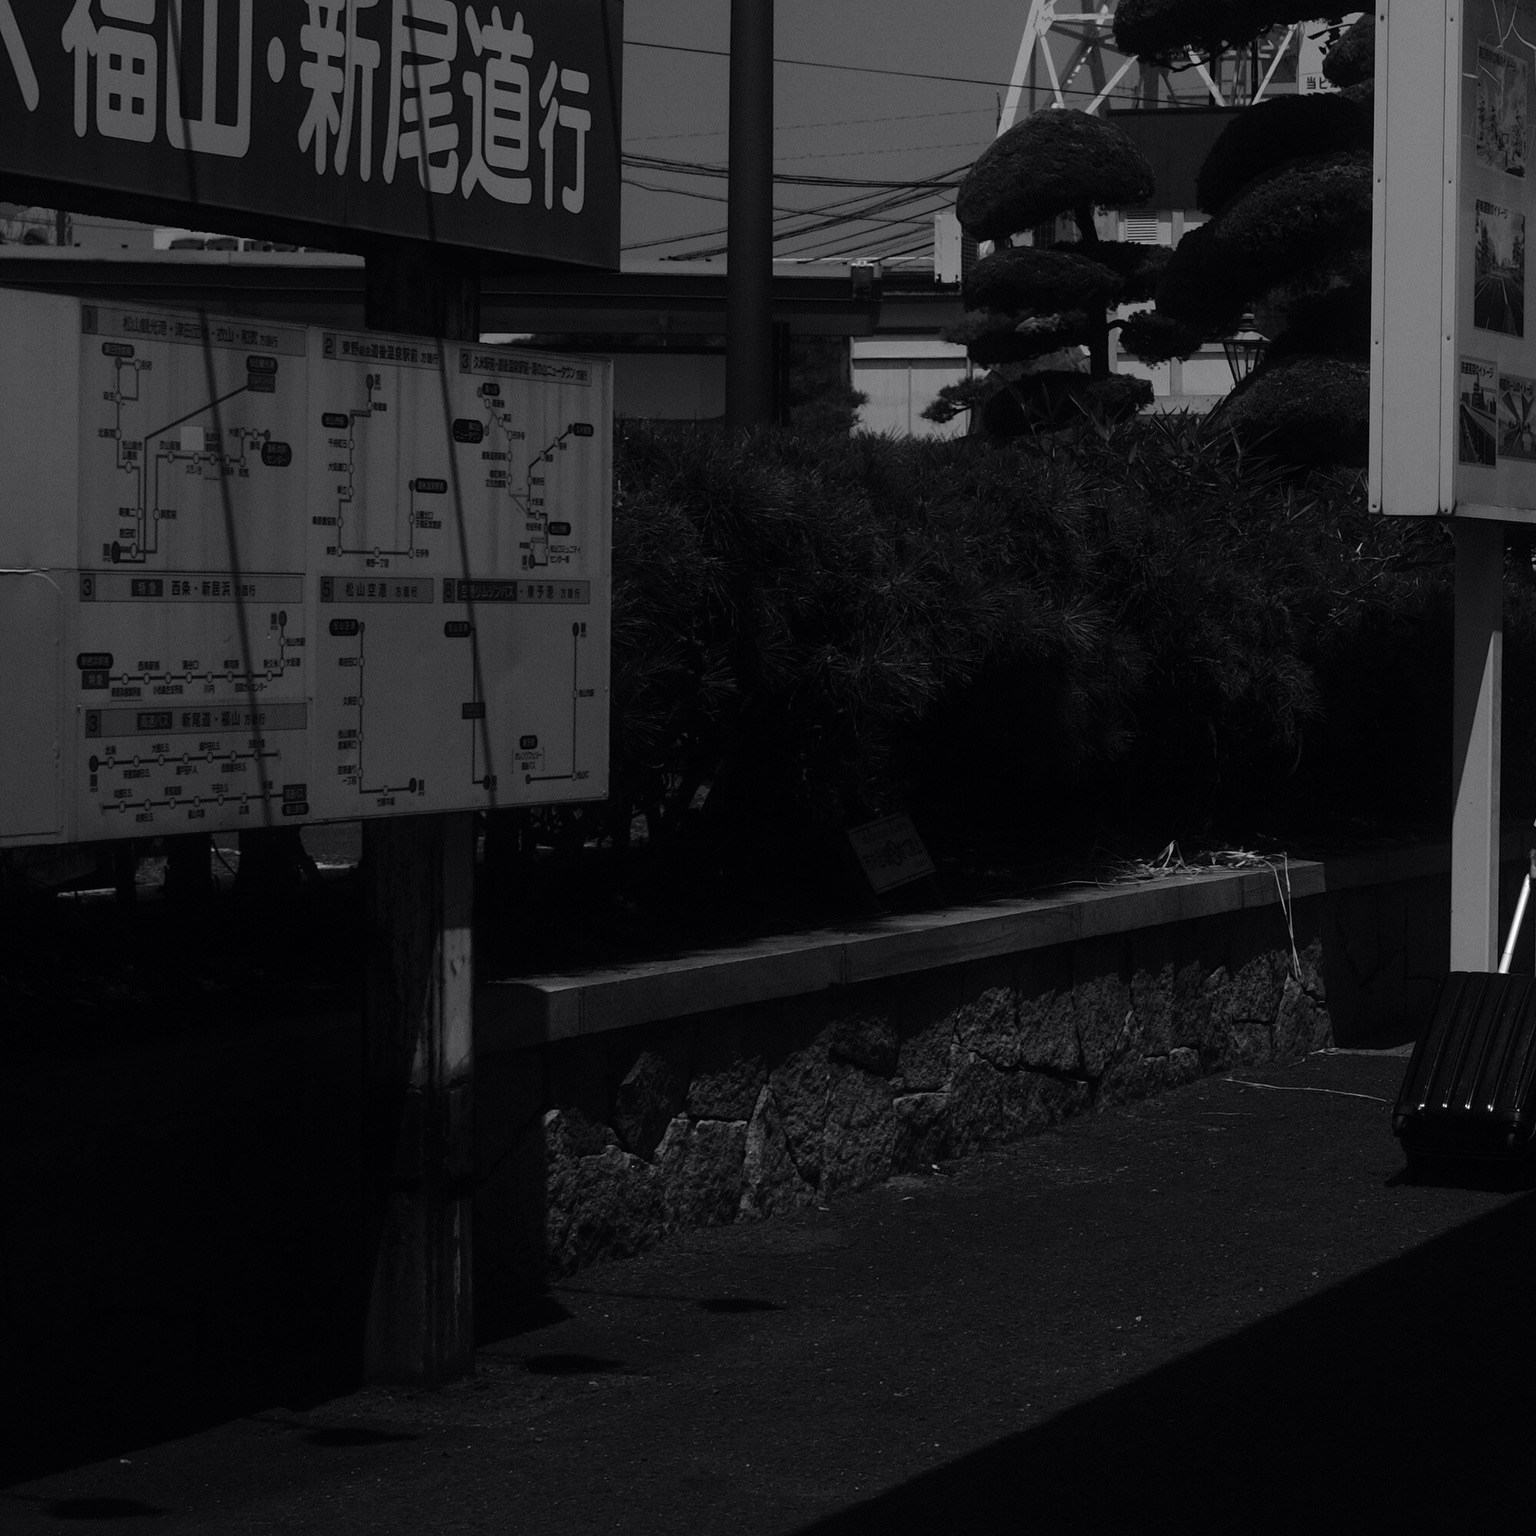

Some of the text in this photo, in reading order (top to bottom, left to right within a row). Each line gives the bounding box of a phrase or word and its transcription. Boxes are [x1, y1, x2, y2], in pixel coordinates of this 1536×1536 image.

[171, 580, 231, 597] 西条・新居浜
[345, 583, 388, 598] 松山空港
[181, 711, 241, 728] 新尾道・福山
